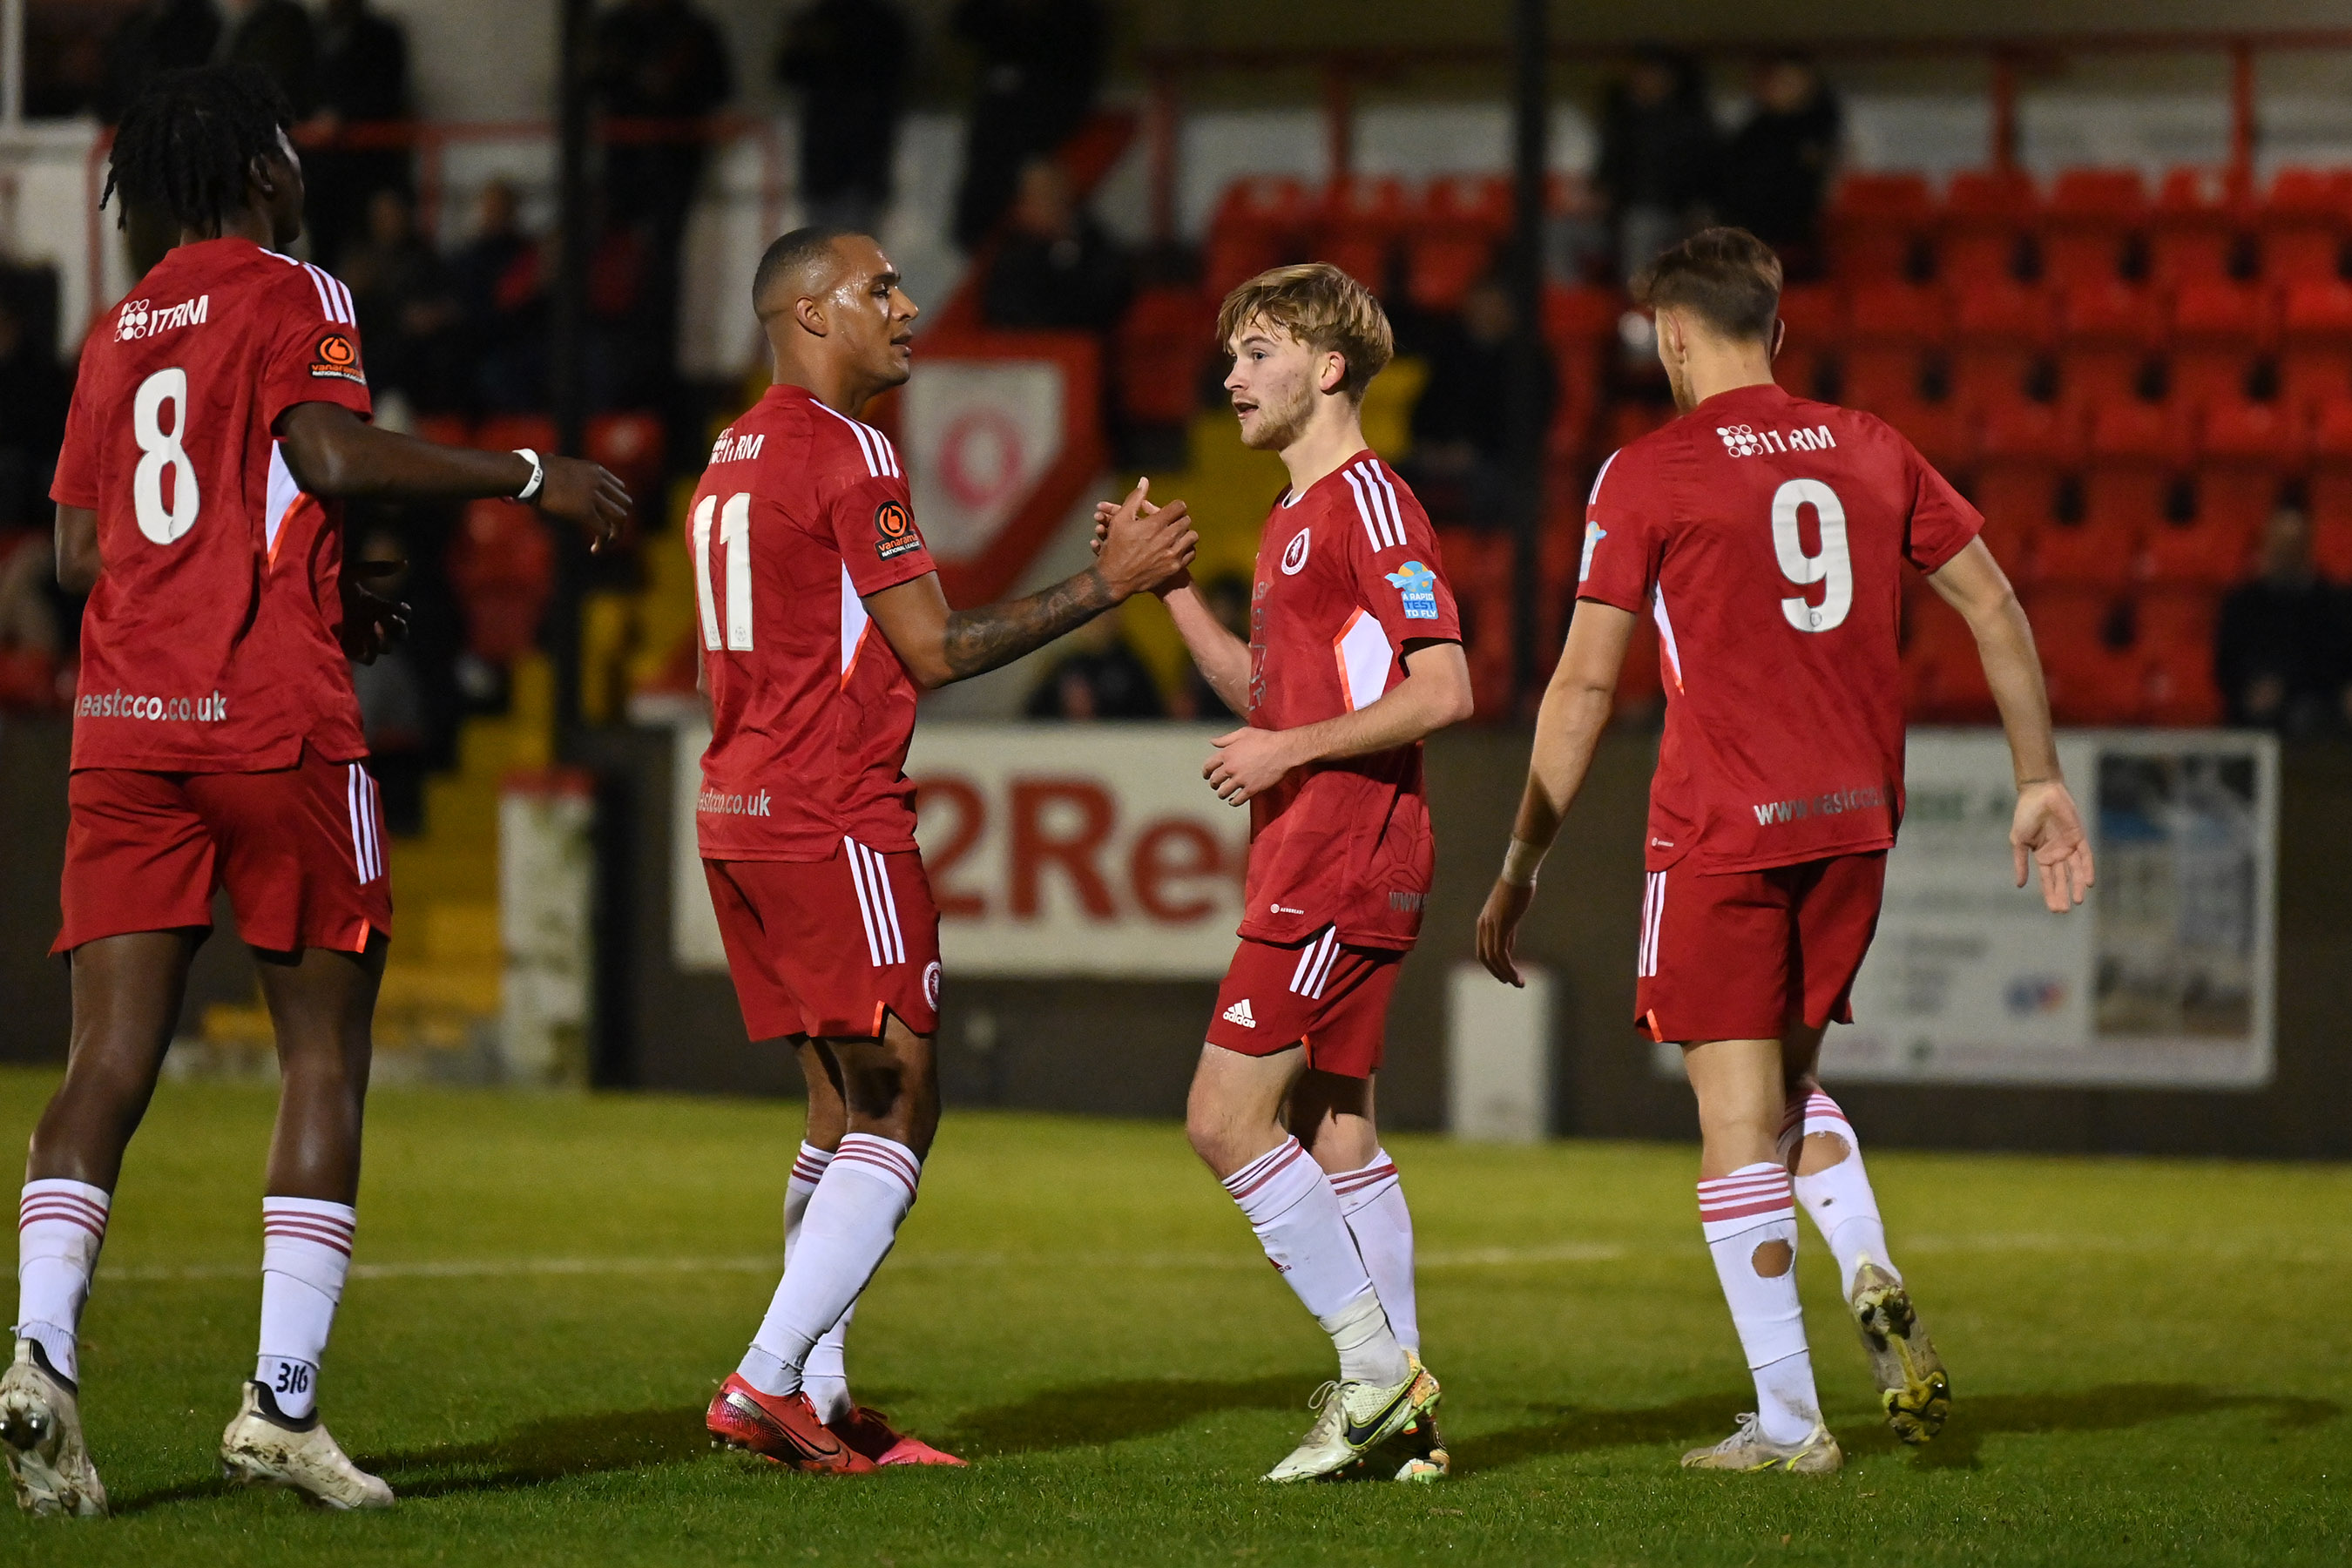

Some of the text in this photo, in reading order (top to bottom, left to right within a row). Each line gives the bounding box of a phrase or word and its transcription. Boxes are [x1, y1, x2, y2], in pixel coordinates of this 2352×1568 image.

[147, 294, 209, 337] ITRM
[133, 367, 200, 545] 8
[1759, 425, 1837, 454] ITRM
[693, 492, 754, 652] 11
[1771, 477, 1854, 633] 9
[1403, 600, 1435, 610] TEST
[1409, 592, 1435, 601] RAPID
[75, 688, 227, 722] .eastcco.co.uk
[915, 774, 1251, 923] 2Re
[1222, 1010, 1256, 1029] adidas
[275, 1362, 308, 1395] 316
